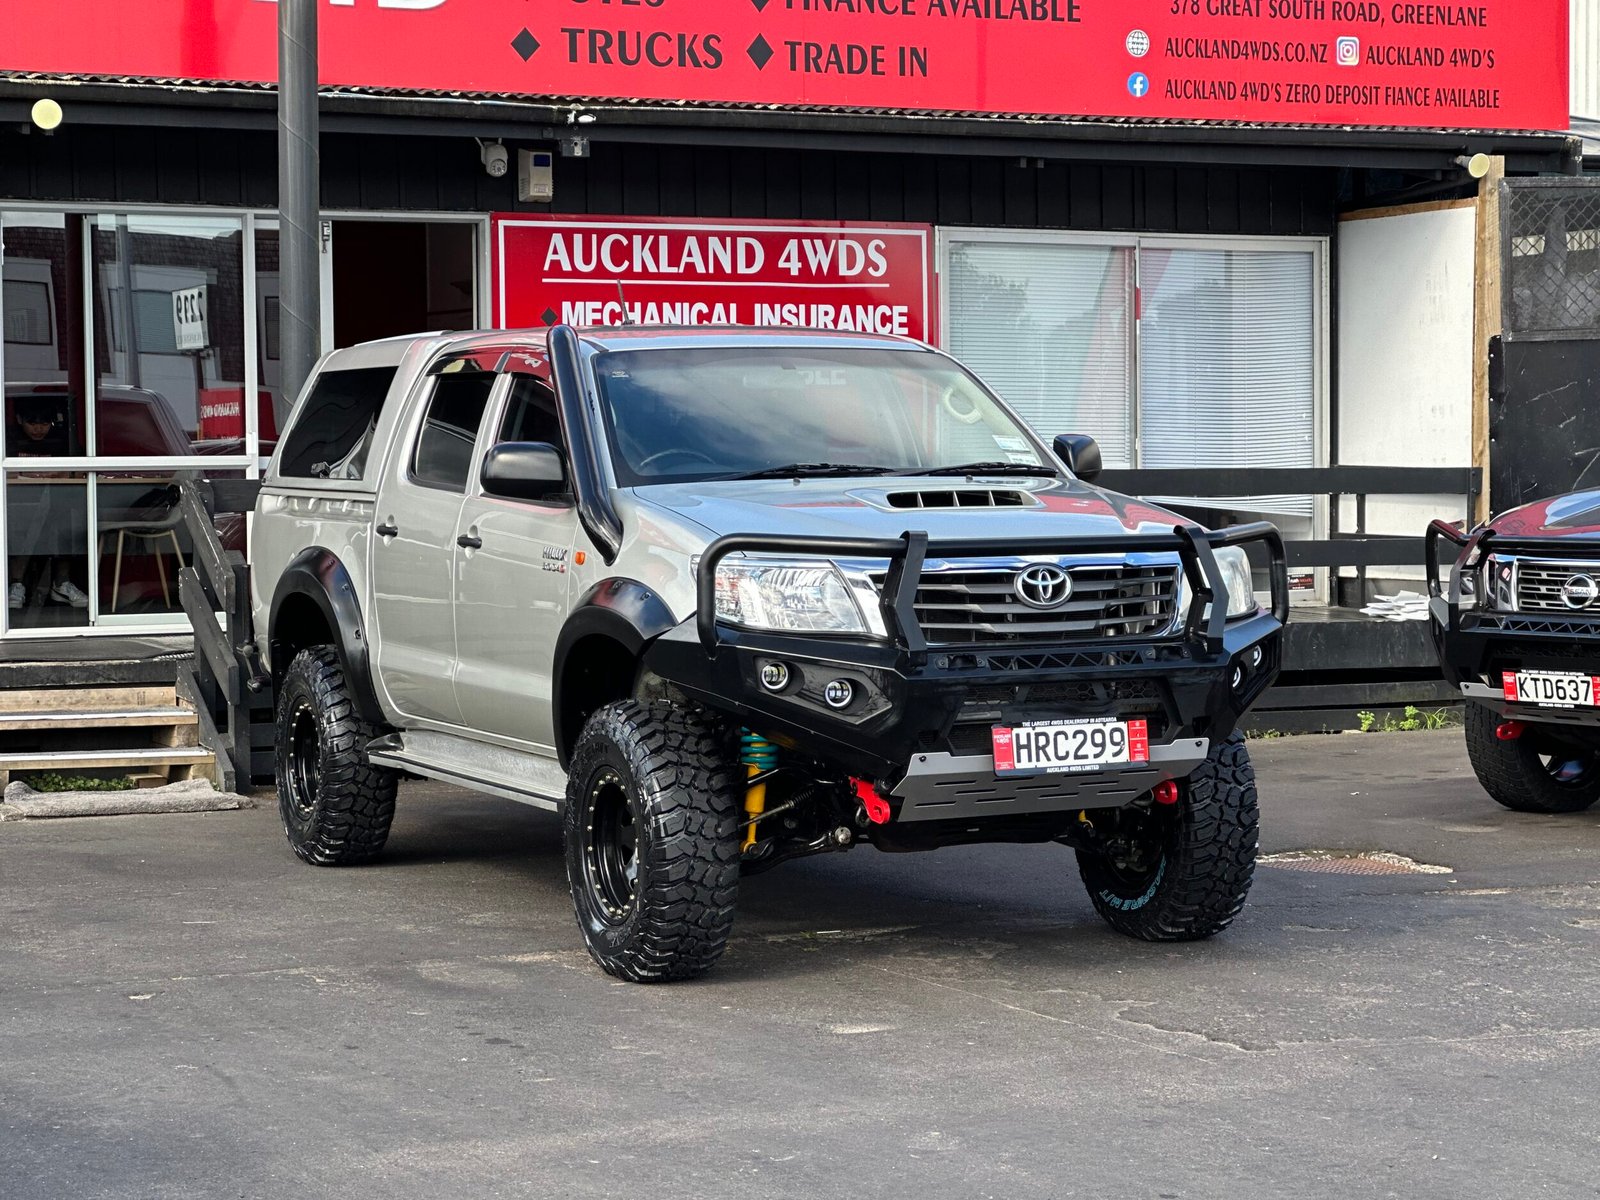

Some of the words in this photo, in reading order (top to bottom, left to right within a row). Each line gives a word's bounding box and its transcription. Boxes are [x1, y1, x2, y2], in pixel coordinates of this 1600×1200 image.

[1170, 0, 1200, 15] 378
[1206, 0, 1260, 17] GREAT
[1269, 0, 1325, 20] SOUTH
[1332, 1, 1385, 28] ROAD,
[1391, 4, 1487, 27] GREENLANE
[560, 27, 722, 69] TRUCKS
[784, 40, 886, 76] TRADE
[899, 46, 927, 77] IN
[1165, 37, 1328, 63] AUCKLAND4WDS.CO.NZ
[1366, 45, 1445, 67] AUCKLAND
[1449, 48, 1495, 69] 4WD'S
[1165, 78, 1237, 101] AUCKLAND
[1240, 82, 1282, 103] 4WD'S
[1285, 83, 1321, 104] ZERO
[1325, 84, 1380, 105] DEPOSIT
[1385, 86, 1430, 107] FIANCE
[1434, 88, 1500, 108] AVAILABLE
[543, 233, 764, 275] AUCKLAND
[778, 238, 888, 277] 4WDS
[562, 301, 737, 327] MECHANICAL
[754, 303, 909, 335] INSURANCE
[1518, 676, 1590, 701] KTD637
[1015, 726, 1125, 763] HRC299
